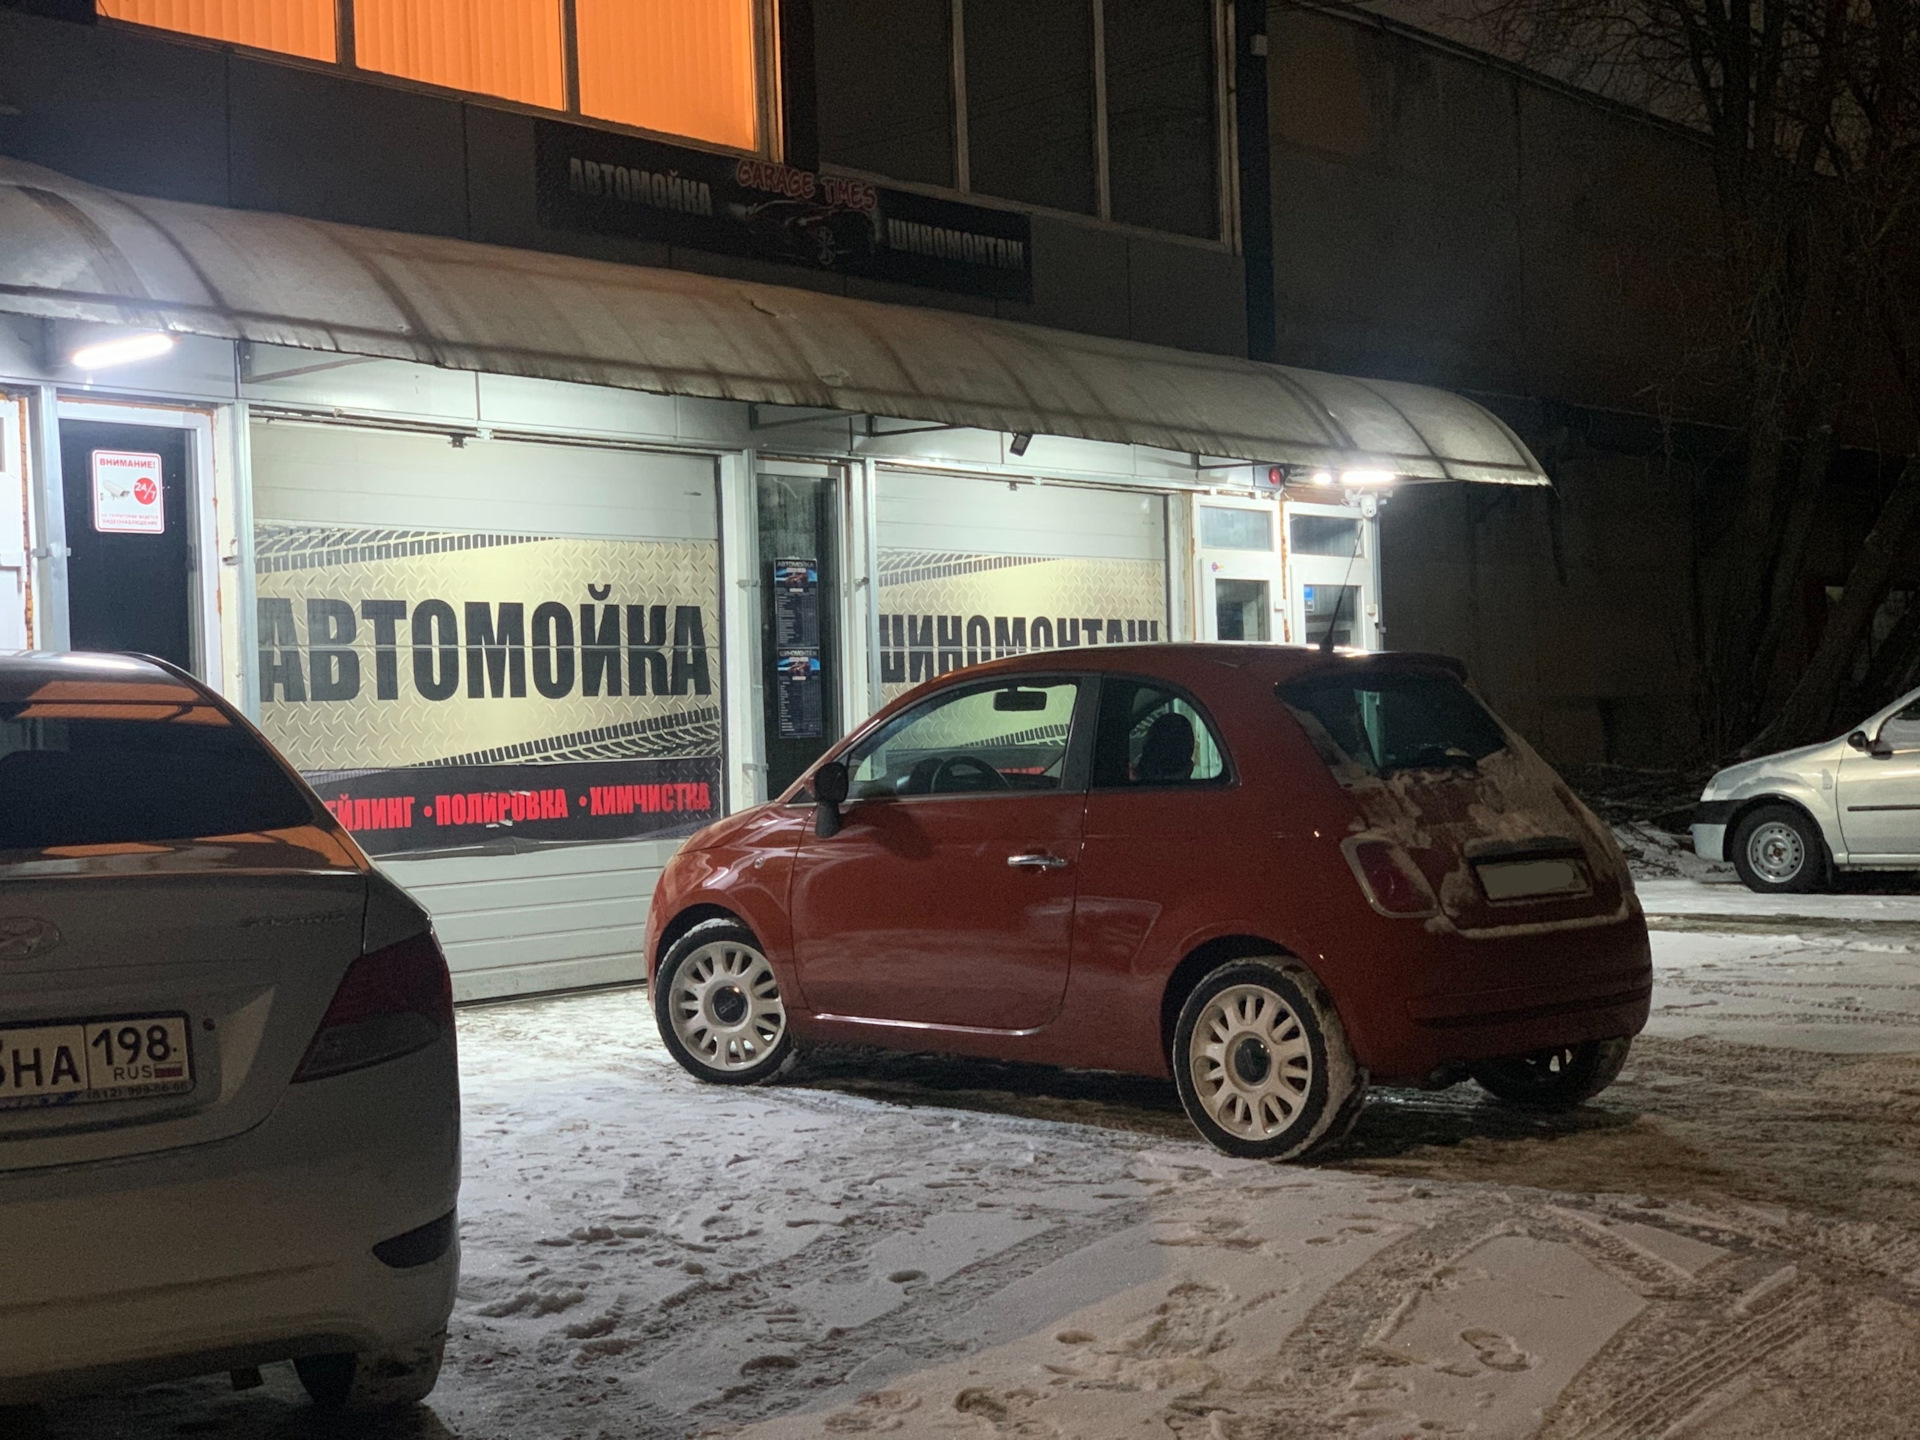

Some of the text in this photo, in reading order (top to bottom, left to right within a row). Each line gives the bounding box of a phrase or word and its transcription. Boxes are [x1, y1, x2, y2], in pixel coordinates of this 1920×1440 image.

[570, 157, 713, 216] АВТОМОЙКА
[736, 158, 879, 211] GARAGE TIMES
[887, 217, 1024, 271] ШИНОМОНТАЖ
[99, 458, 156, 469] ВНИМАНИЕ!
[134, 482, 157, 501] 24/7
[257, 583, 712, 702] АВТОМОЙКА
[435, 788, 568, 826] ПОЛИРОВКА
[590, 782, 711, 817] ХИМЧИСТКА
[92, 1025, 170, 1065] 198
[114, 1066, 153, 1081] RUS
